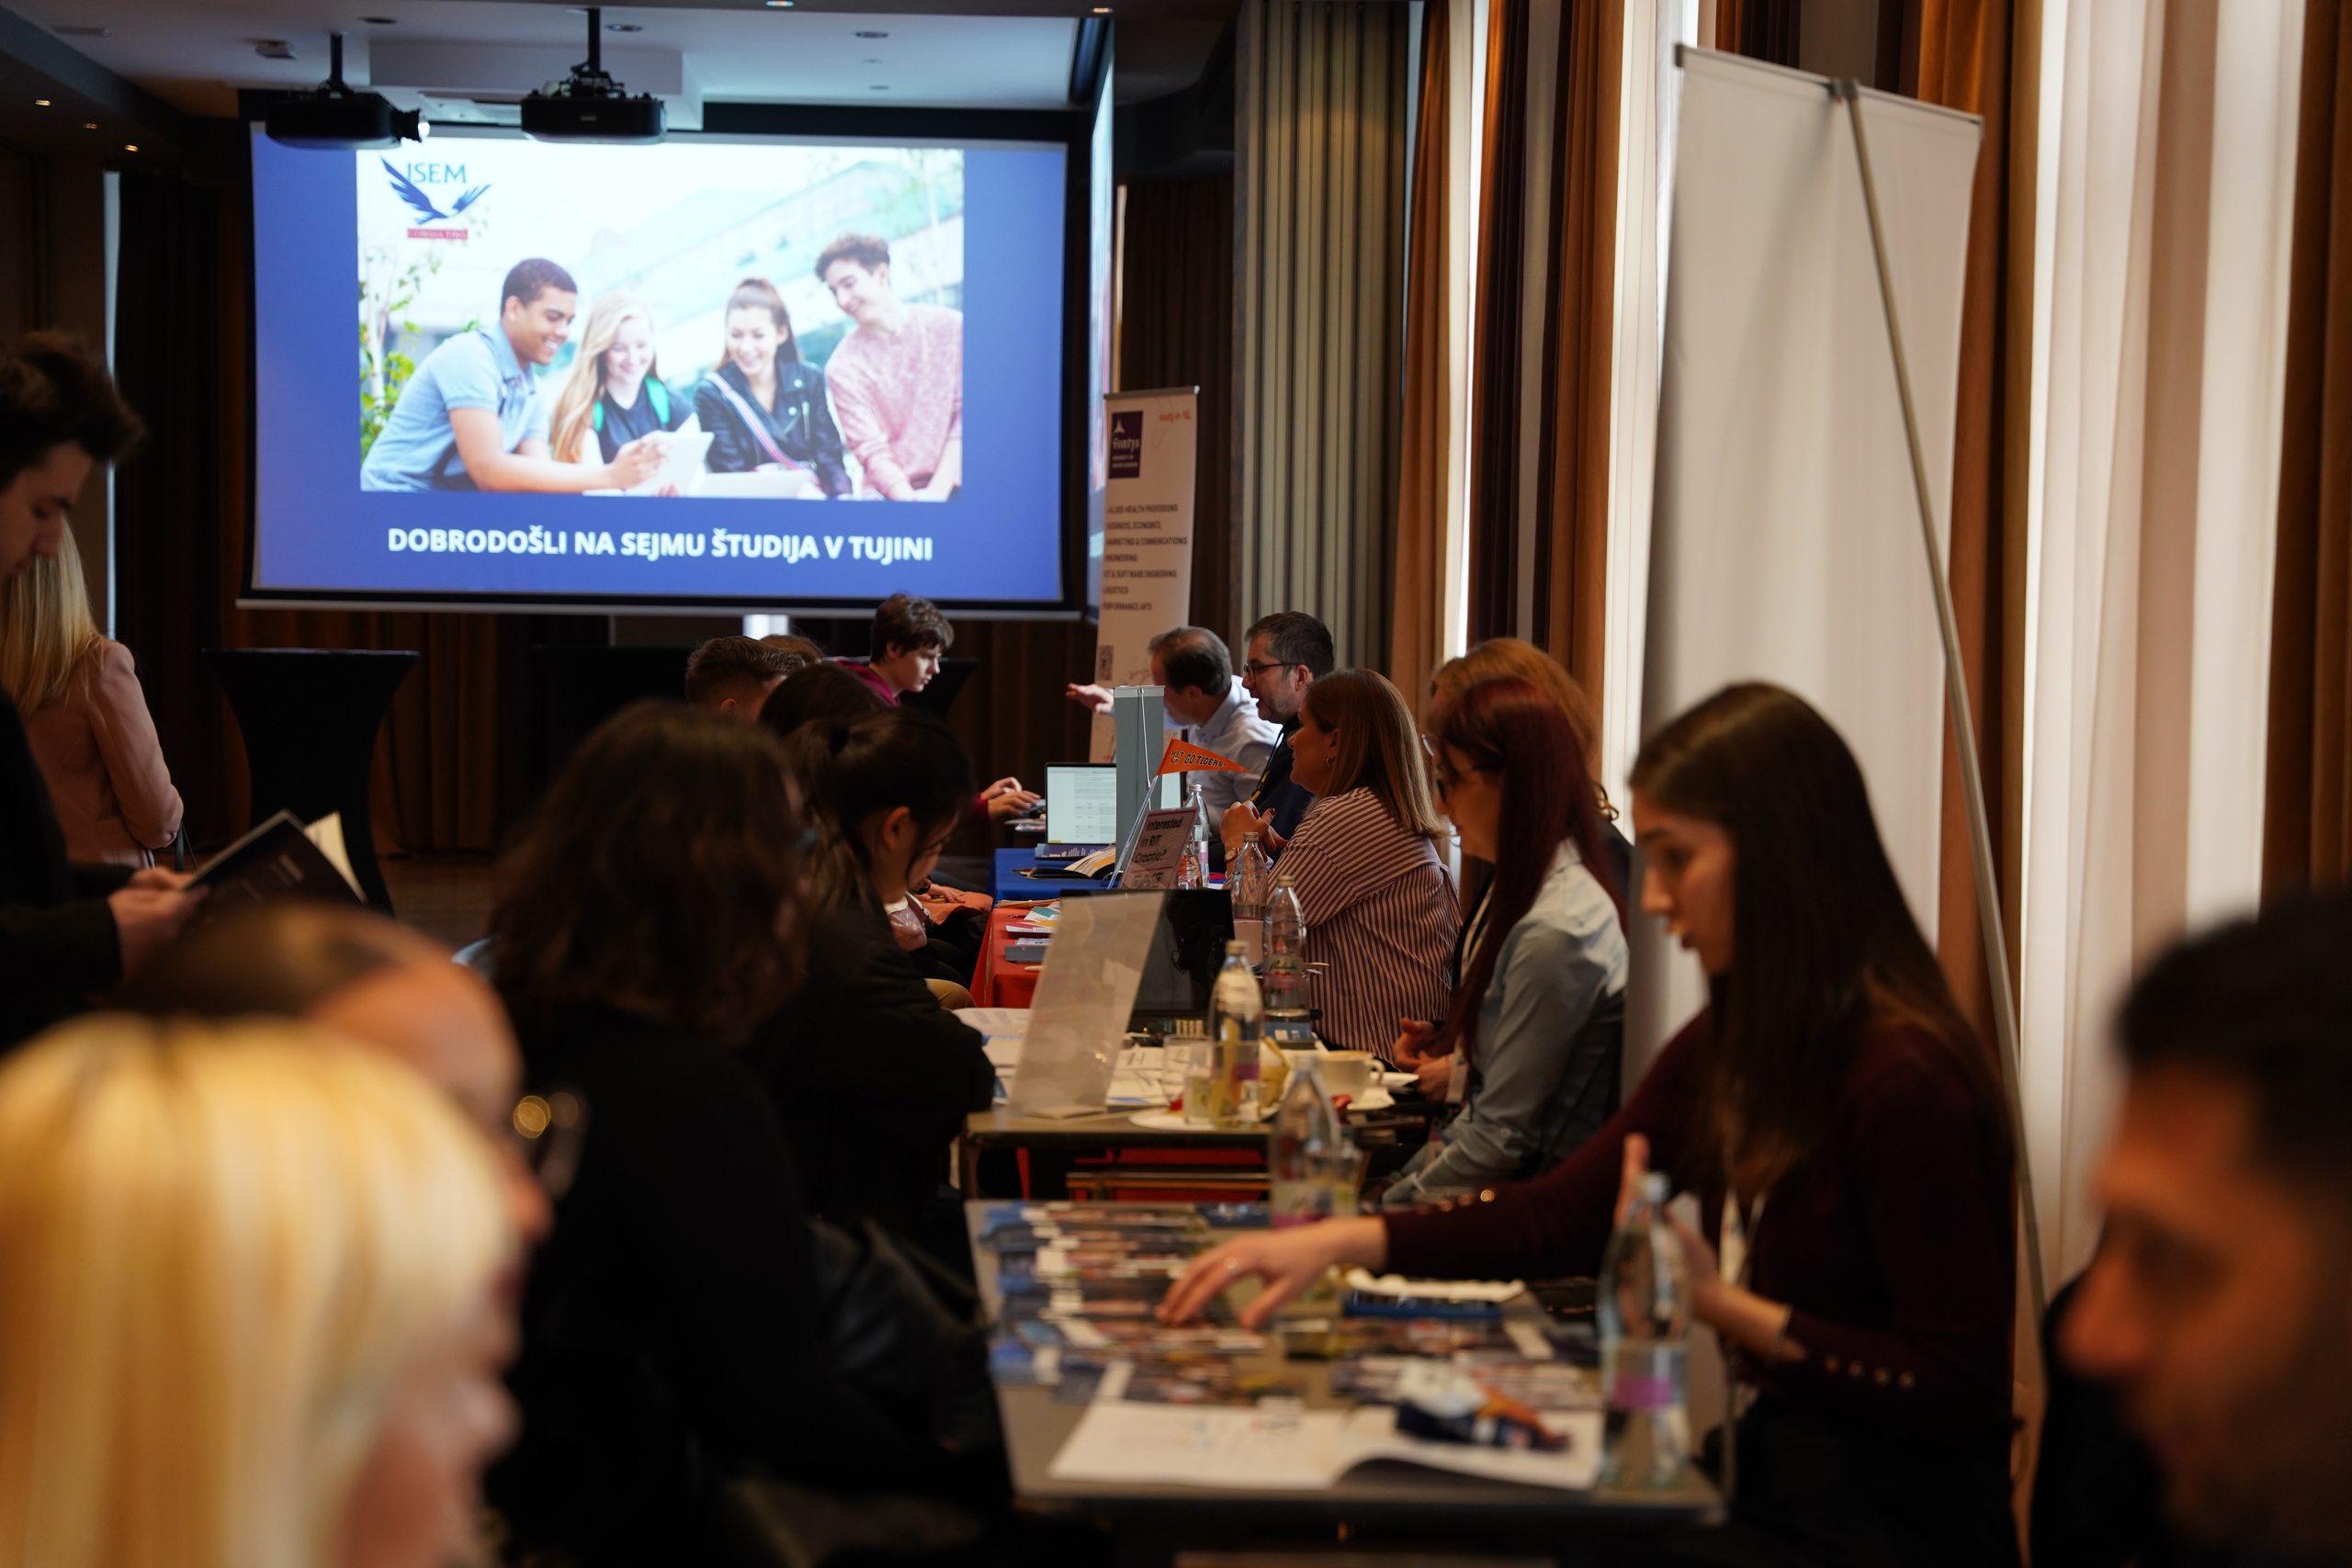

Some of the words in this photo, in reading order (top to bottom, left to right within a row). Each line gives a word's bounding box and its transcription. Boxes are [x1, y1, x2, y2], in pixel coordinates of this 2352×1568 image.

[407, 163, 467, 184] ISEM
[388, 525, 567, 554] DOBRODOŠLI
[574, 531, 616, 556] NA
[620, 532, 706, 562] SEJMU
[711, 527, 820, 564] ŠTUDIJA
[823, 535, 844, 559] V
[848, 536, 933, 566] TUJINI
[1184, 752, 1196, 765] GO
[1195, 754, 1227, 768] TIGERS!
[1146, 817, 1183, 831] Interested
[1148, 834, 1161, 847] RIT
[1135, 849, 1167, 863] Croatia?
